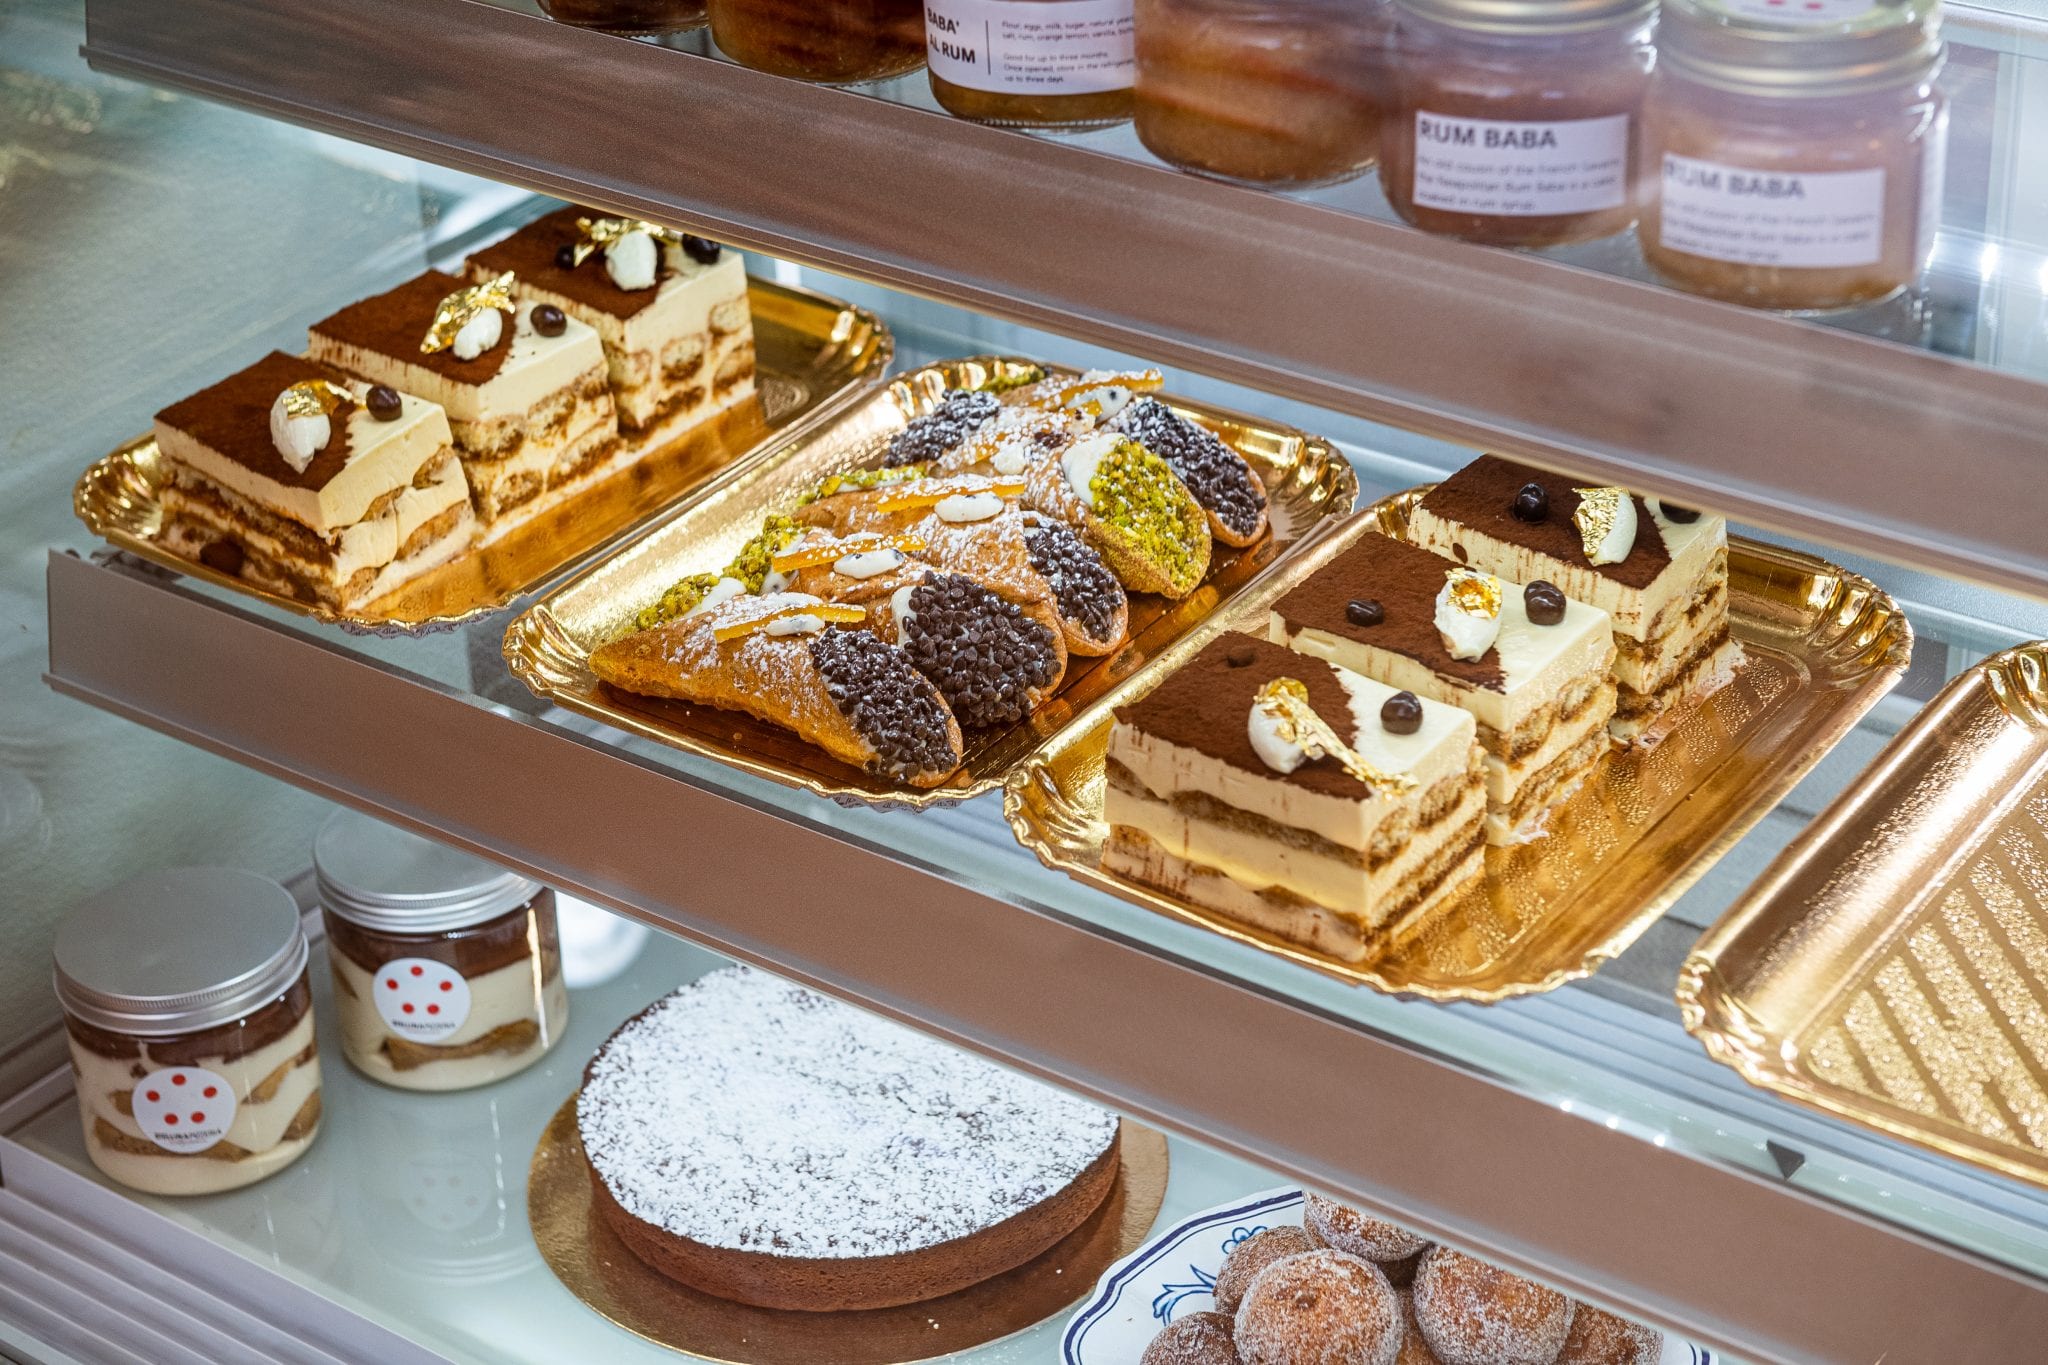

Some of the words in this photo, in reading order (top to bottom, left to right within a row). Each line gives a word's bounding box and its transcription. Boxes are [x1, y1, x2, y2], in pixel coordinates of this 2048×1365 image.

[942, 41, 975, 64] RUM
[1419, 119, 1475, 146] RUM
[1484, 127, 1558, 150] BABA
[1727, 173, 1805, 199] BABA
